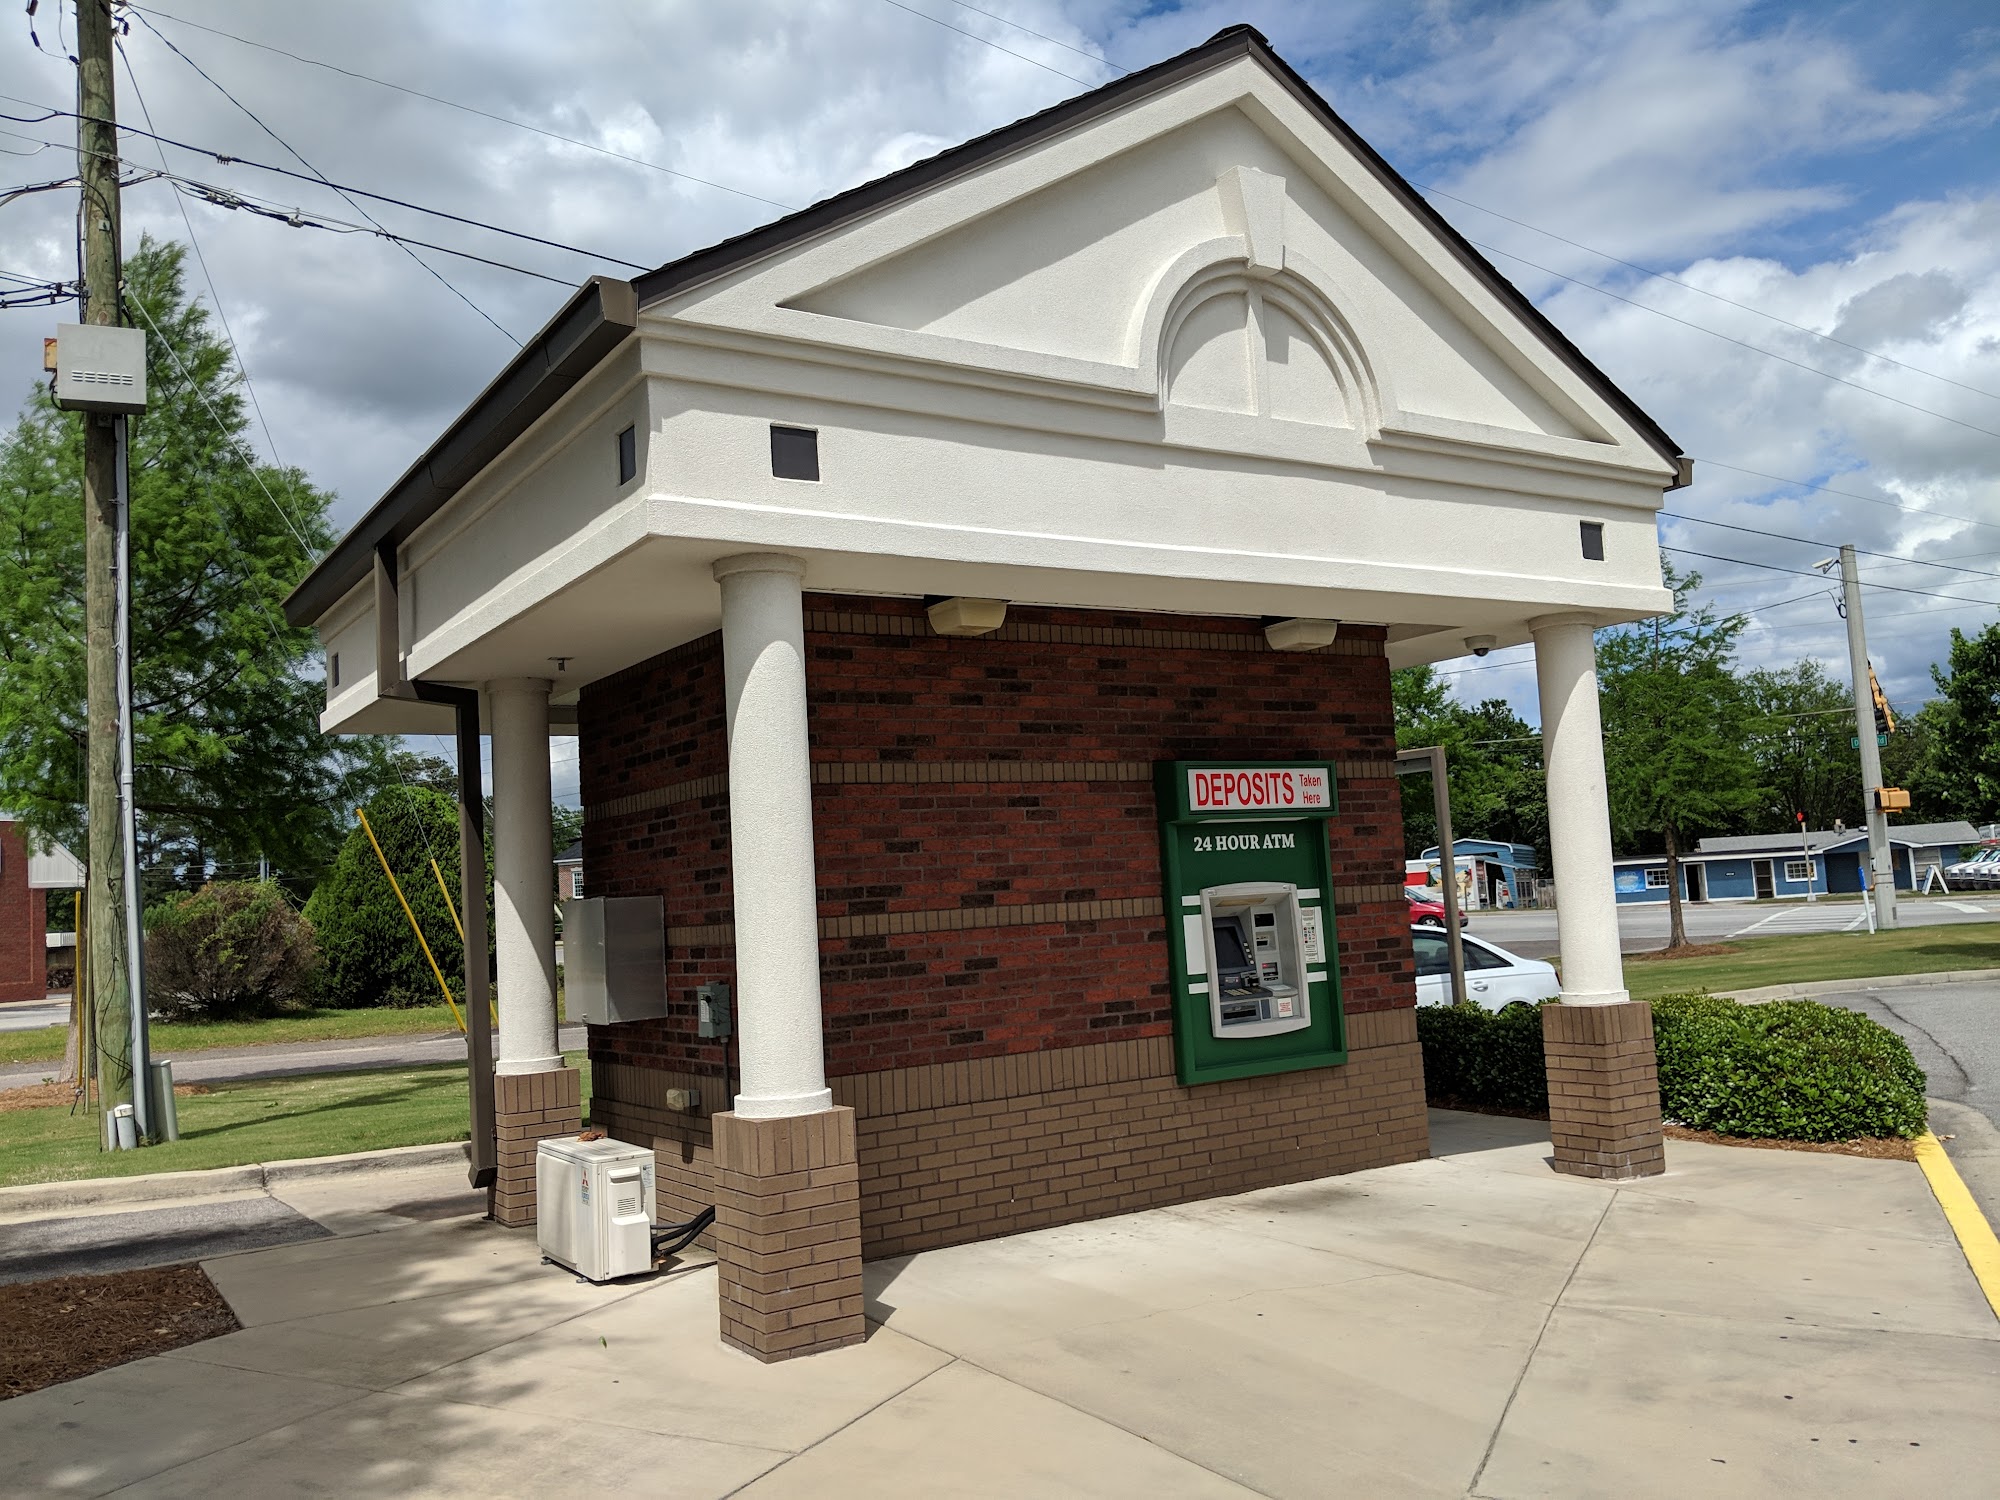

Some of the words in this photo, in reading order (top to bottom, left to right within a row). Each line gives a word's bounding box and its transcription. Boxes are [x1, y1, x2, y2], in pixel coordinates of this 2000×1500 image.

[1299, 774, 1322, 787] Taken
[1195, 772, 1295, 806] DEPOSITS
[1302, 791, 1321, 804] Here
[1193, 836, 1213, 852] 24
[1215, 834, 1260, 851] HOUR
[1263, 833, 1295, 849] ATM
